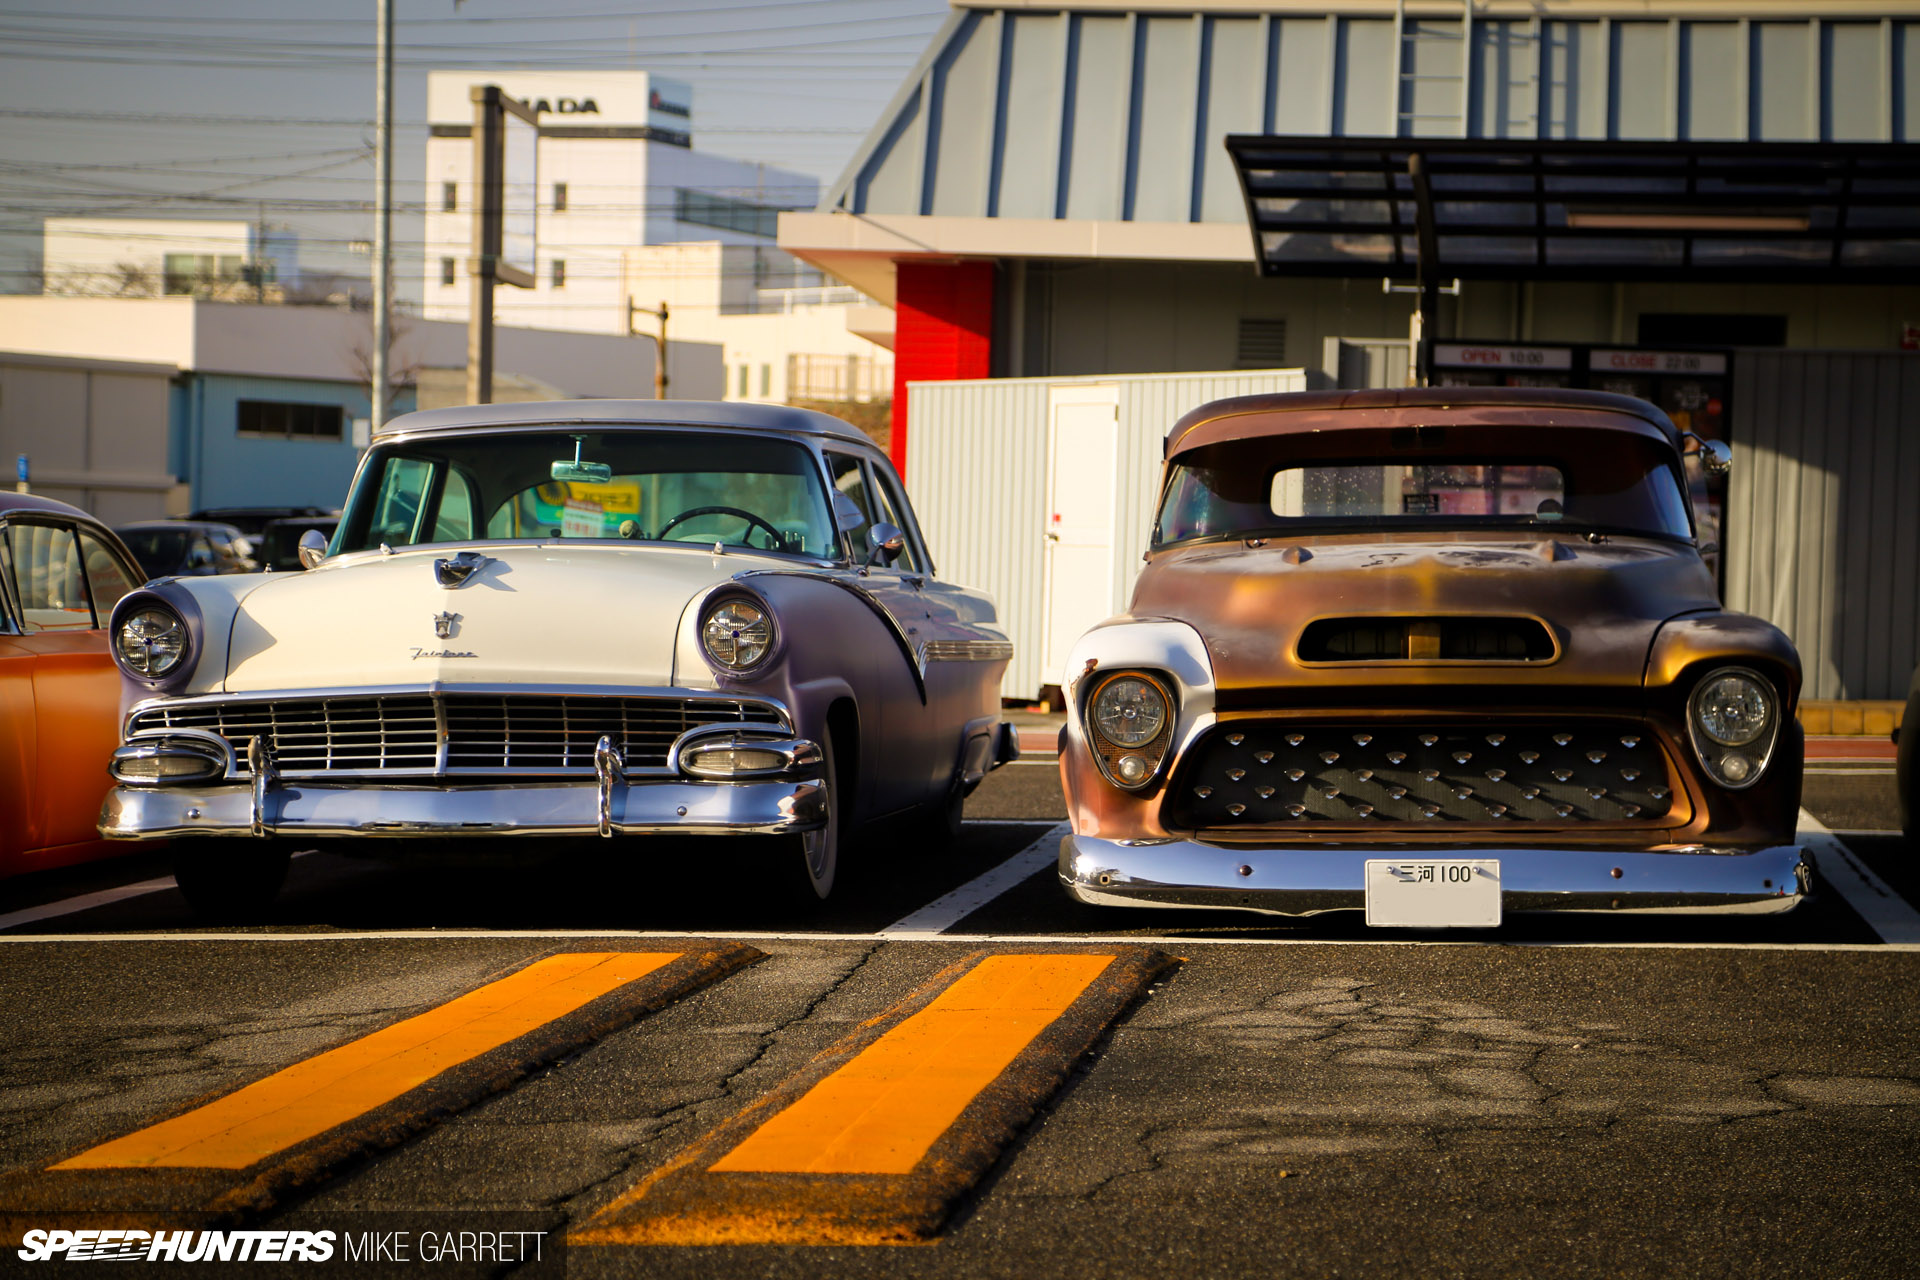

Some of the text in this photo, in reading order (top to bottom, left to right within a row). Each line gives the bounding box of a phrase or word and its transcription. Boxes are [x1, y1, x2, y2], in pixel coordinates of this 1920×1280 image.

[520, 98, 600, 114] ADA
[1461, 348, 1544, 365] OPEN 10:00
[1610, 354, 1657, 369] CLOSE
